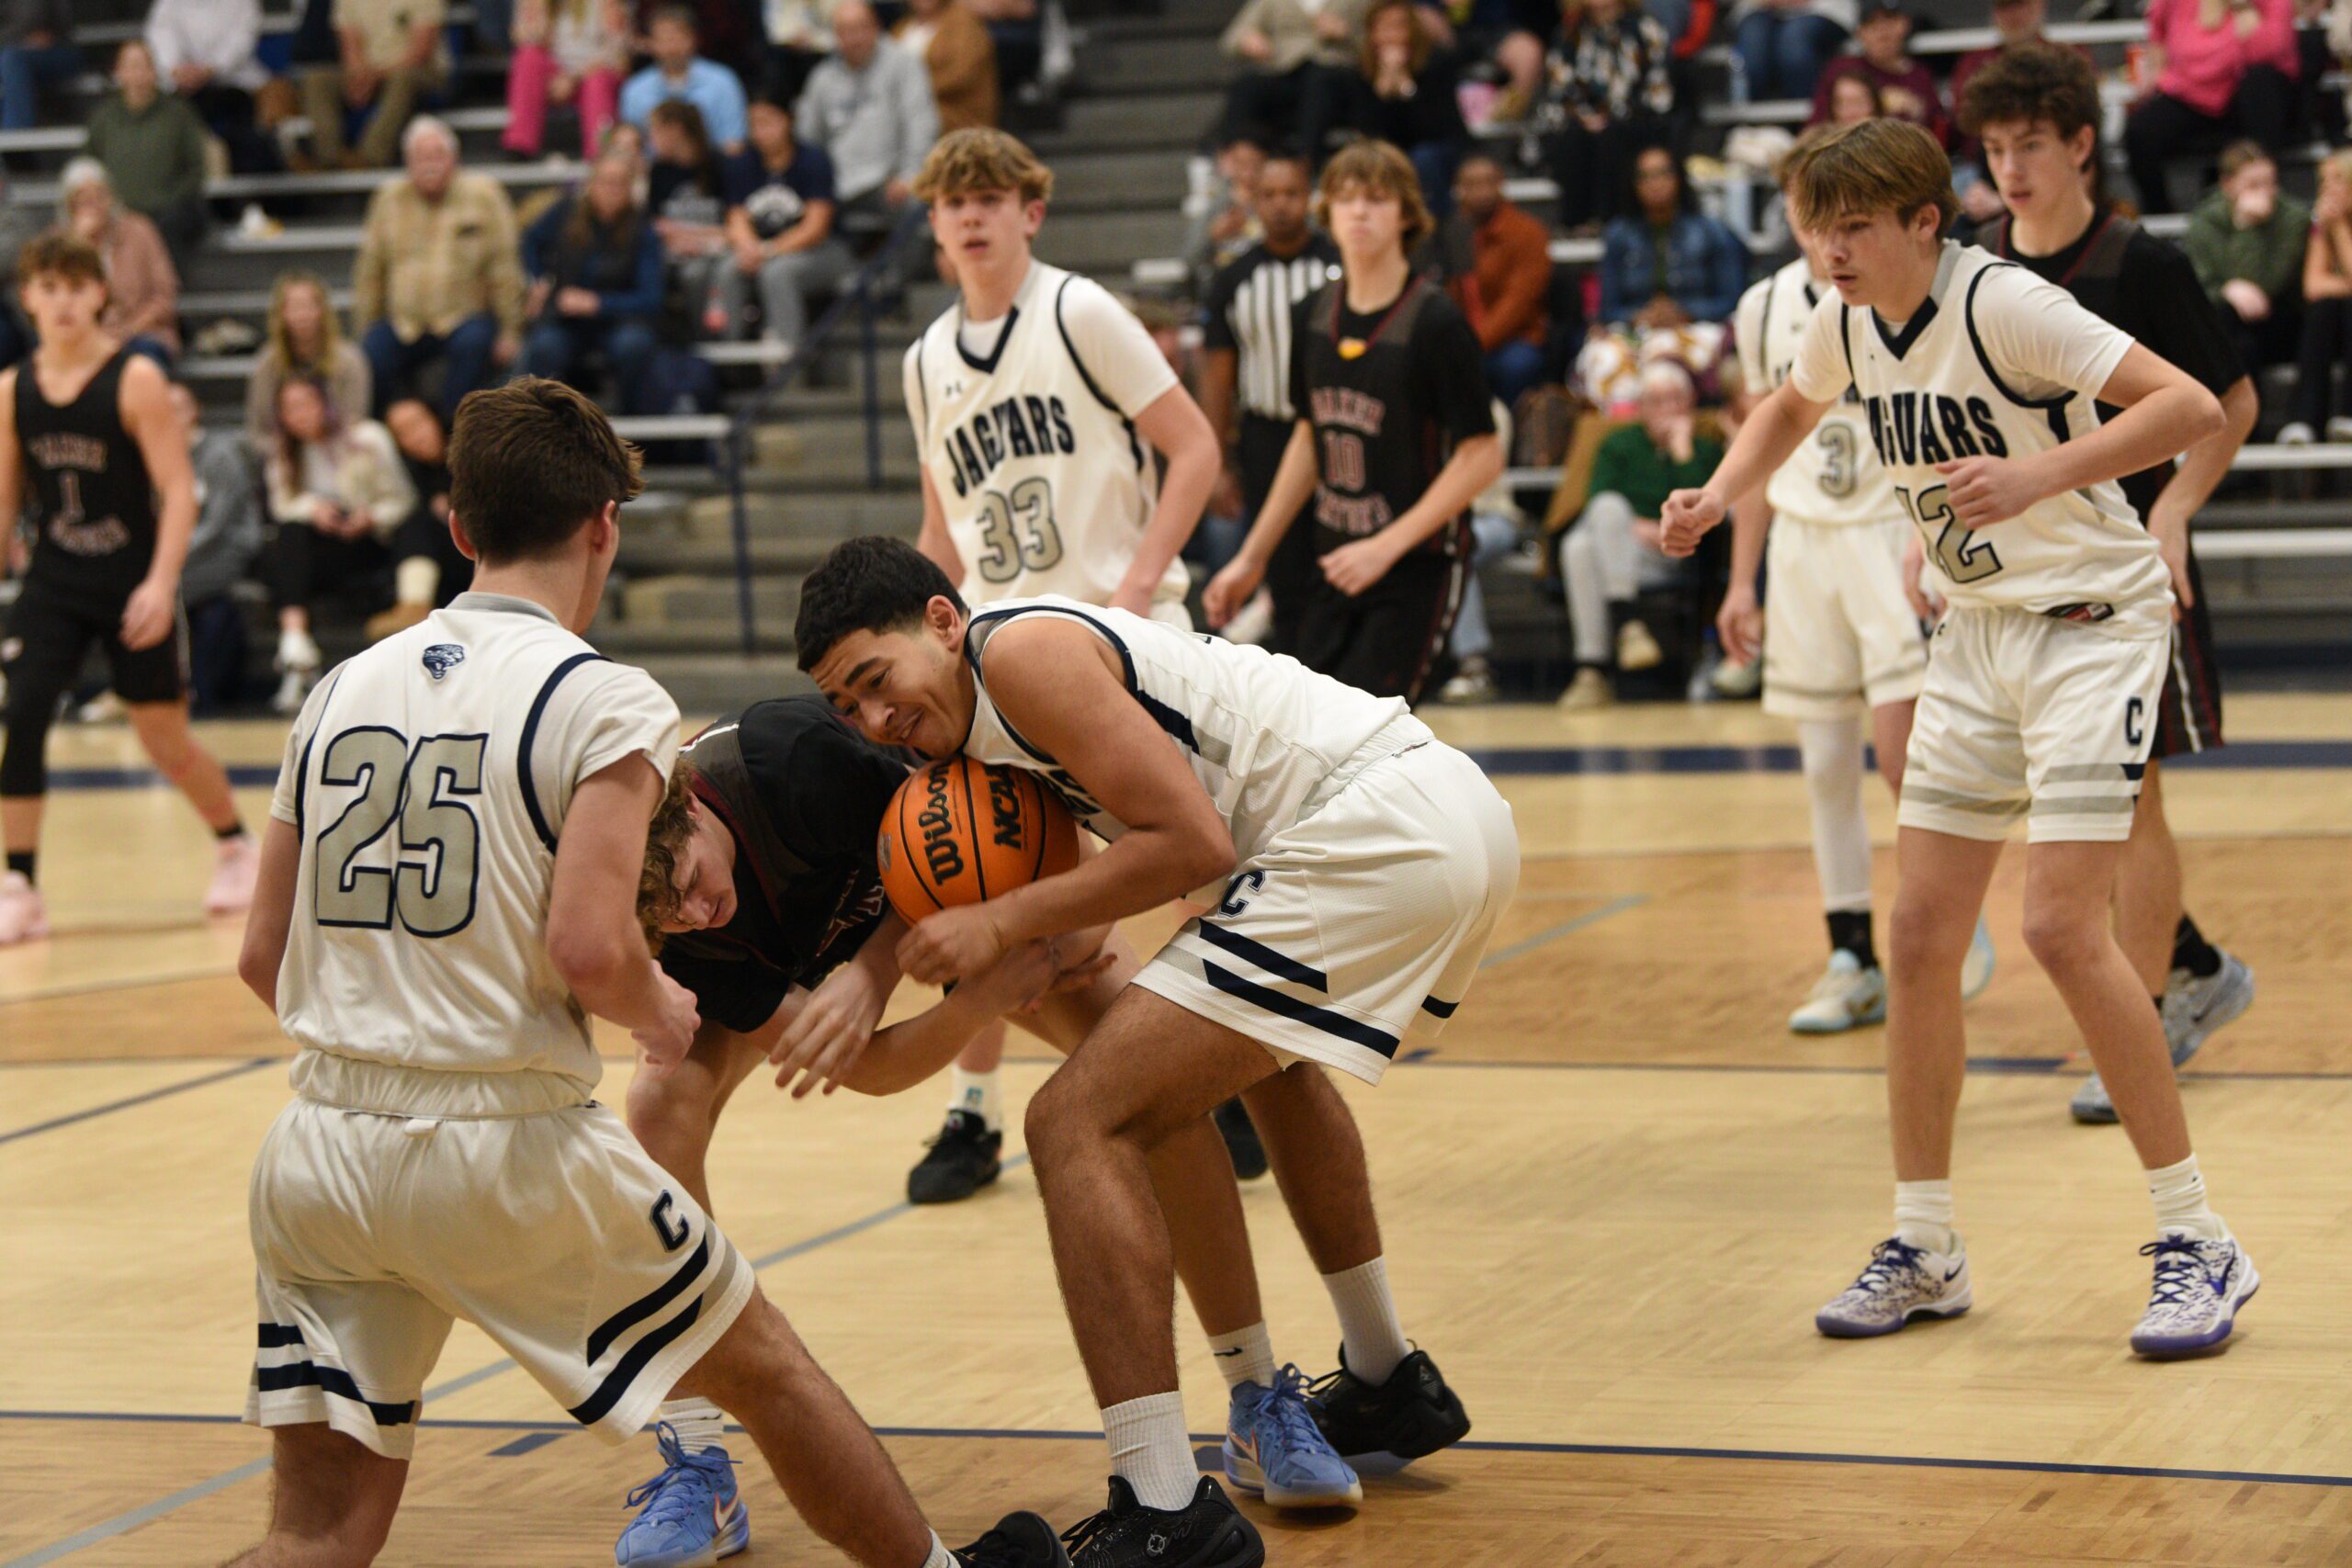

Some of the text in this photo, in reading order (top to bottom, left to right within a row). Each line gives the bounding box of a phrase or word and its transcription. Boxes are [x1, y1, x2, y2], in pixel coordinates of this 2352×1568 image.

[1323, 430, 1366, 491] 10
[1818, 423, 1857, 499] 3
[976, 476, 1063, 583] 33
[2125, 696, 2143, 747] C
[315, 725, 490, 939] 25
[919, 759, 965, 886] Wilson
[1218, 870, 1266, 918] C
[649, 1189, 690, 1253] C
